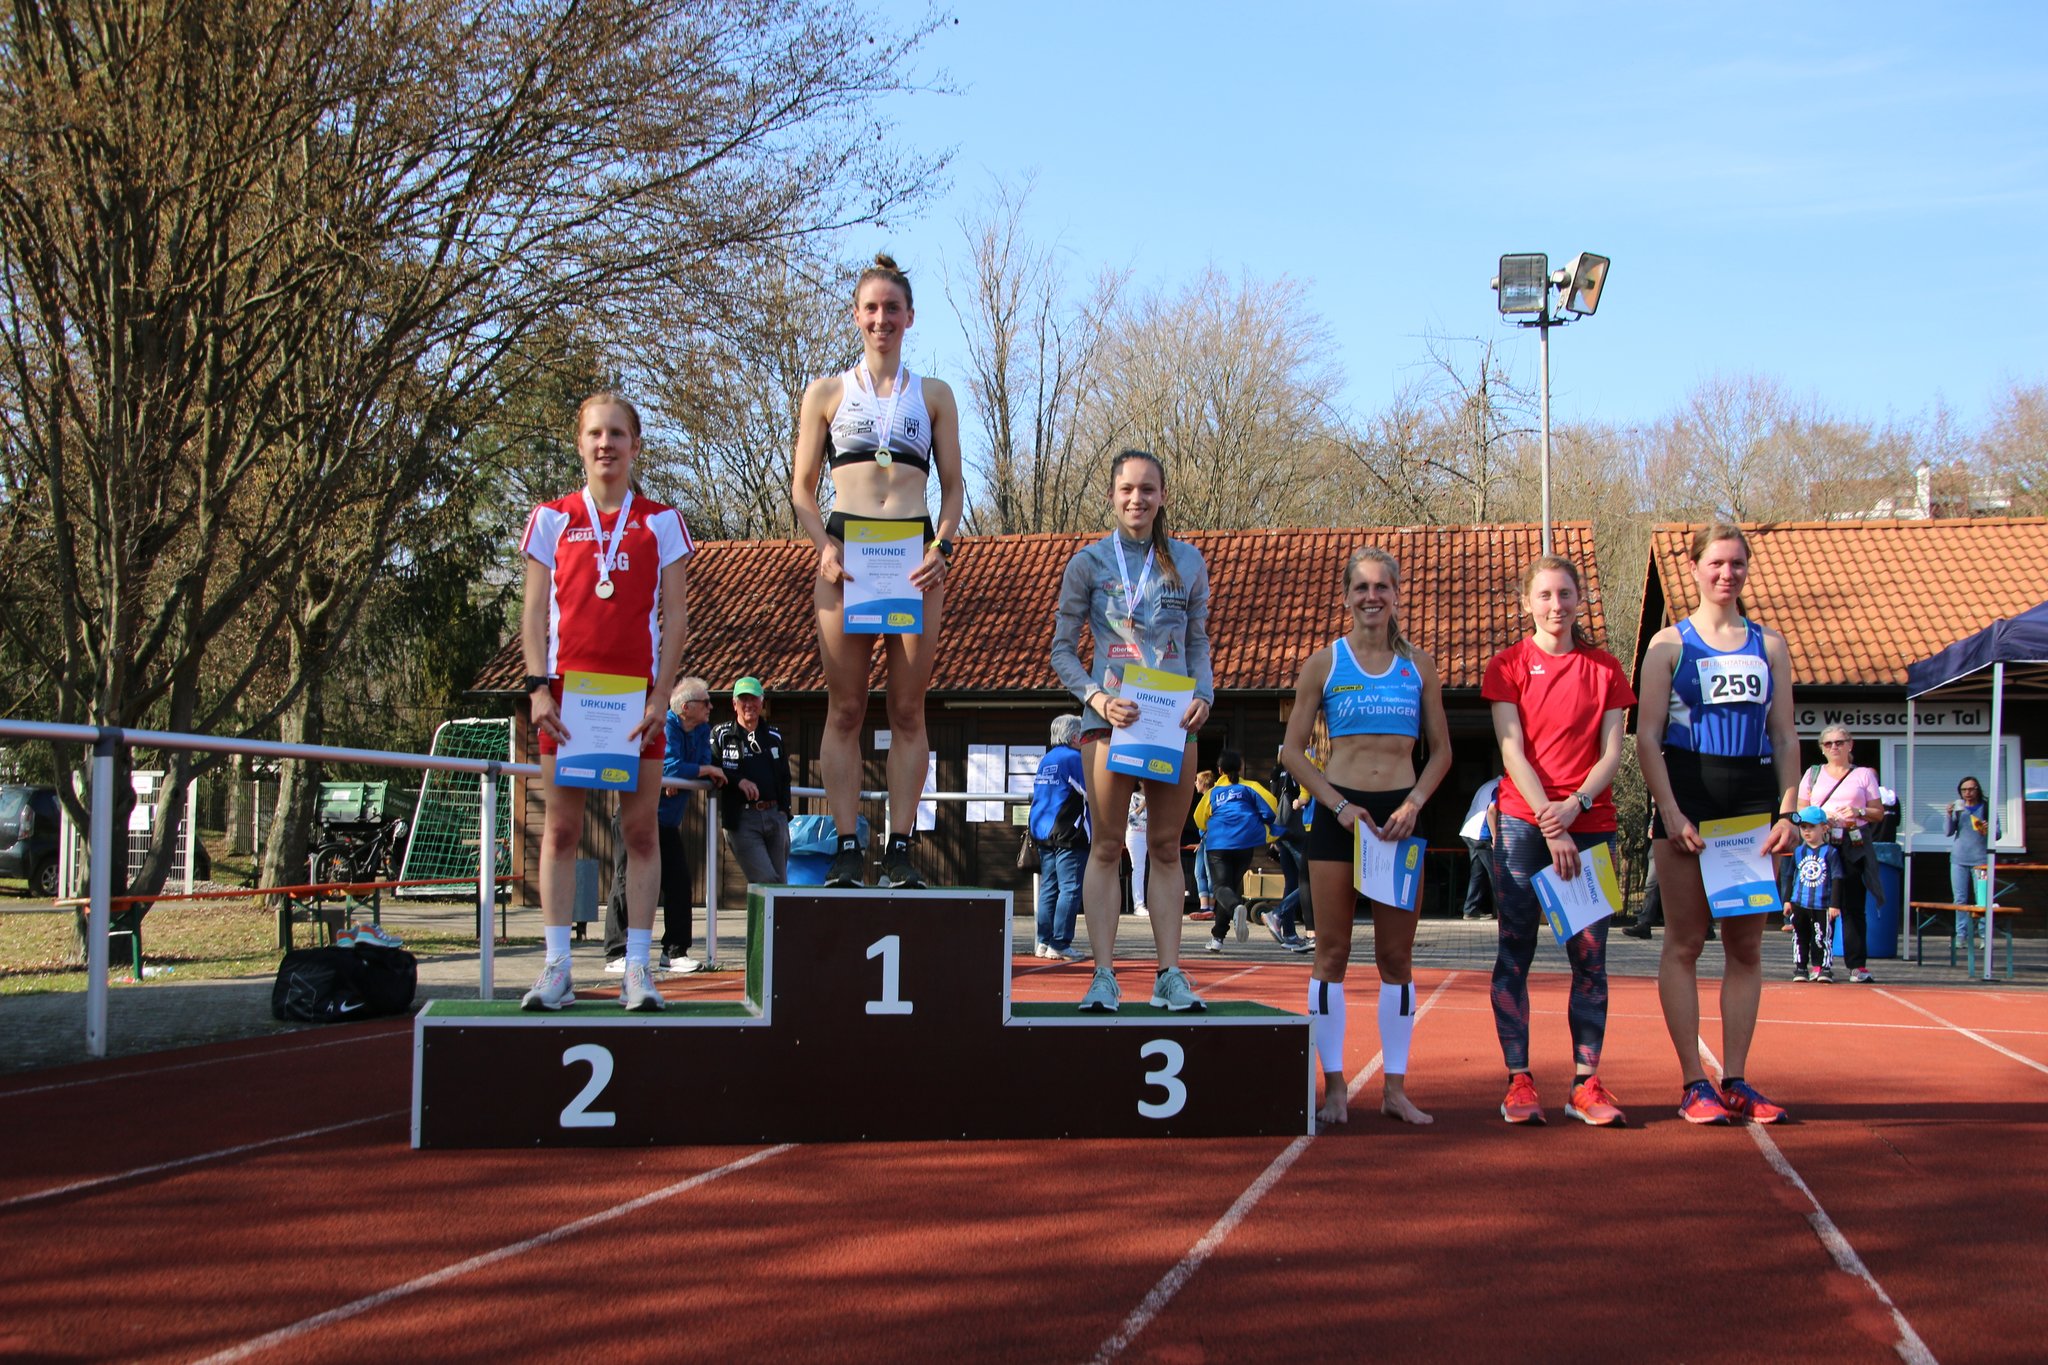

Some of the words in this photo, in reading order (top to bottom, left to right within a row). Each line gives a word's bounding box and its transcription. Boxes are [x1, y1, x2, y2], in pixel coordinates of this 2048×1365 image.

[567, 528, 628, 543] Teusr
[862, 547, 906, 556] URKUNDE
[1711, 674, 1761, 697] 259
[581, 699, 627, 711] URKUNDE
[1136, 691, 1177, 708] URKUNDE
[1357, 694, 1380, 703] LAV
[1358, 704, 1416, 716] TÜBINGEN
[1952, 709, 1981, 726] Tal
[1714, 837, 1756, 848] URKUNDE
[1583, 865, 1599, 905] URKUNDE
[865, 935, 914, 1015] 1
[560, 1043, 617, 1129] 2
[1137, 1038, 1187, 1120] 3
